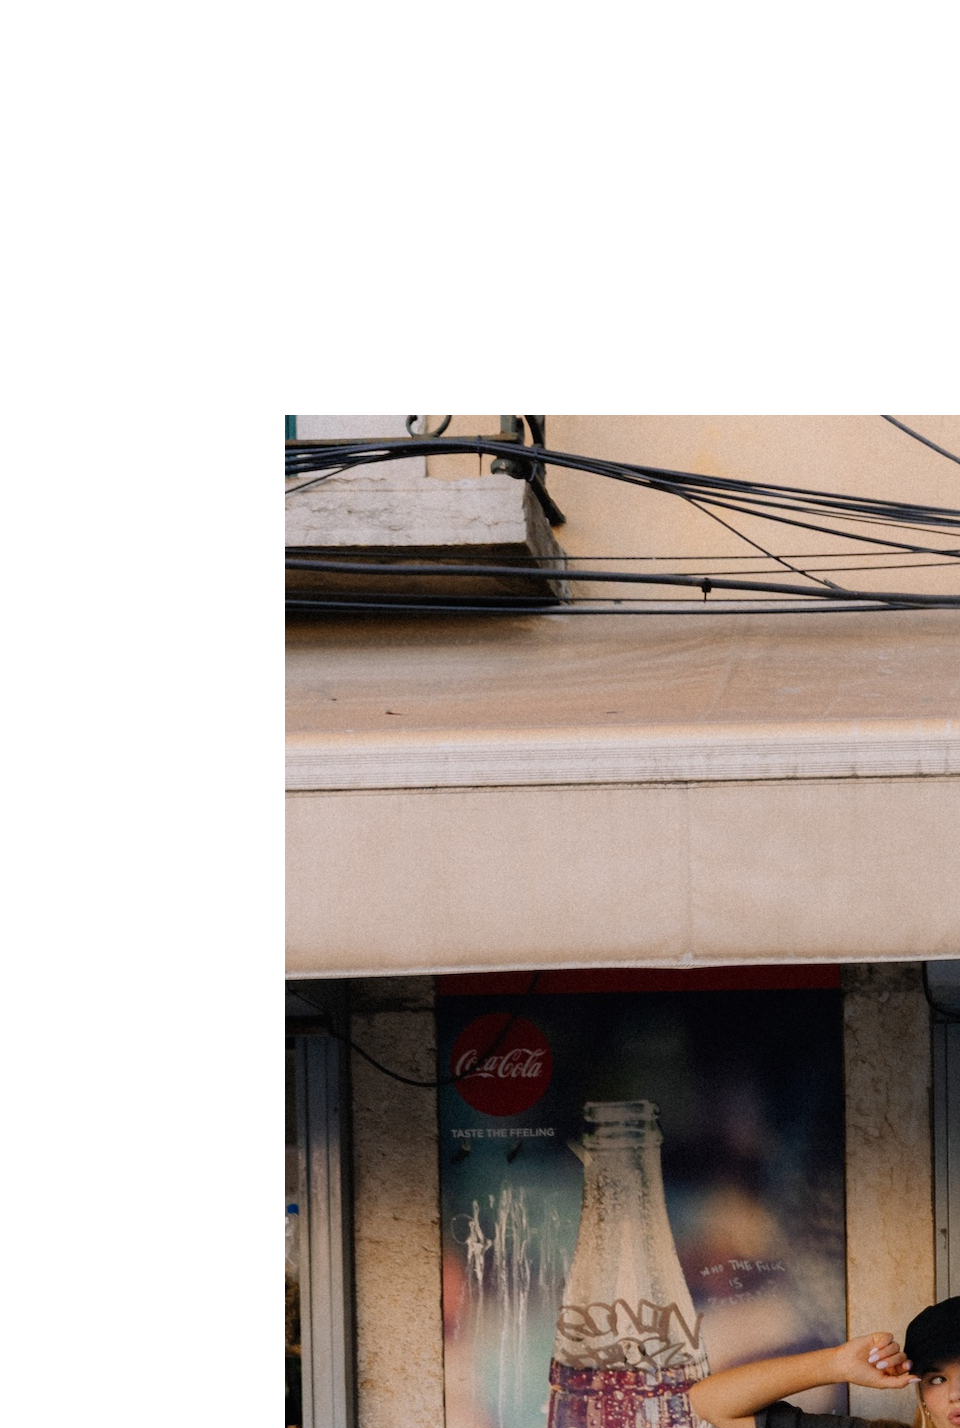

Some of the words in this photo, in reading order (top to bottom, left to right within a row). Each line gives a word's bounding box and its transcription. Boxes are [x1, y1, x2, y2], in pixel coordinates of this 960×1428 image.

[451, 1129, 485, 1138] TASTE
[486, 1129, 508, 1138] THE
[509, 1128, 555, 1137] FEELING
[700, 1264, 725, 1278] WHO
[728, 1260, 753, 1272] THE
[728, 1277, 743, 1289] IS
